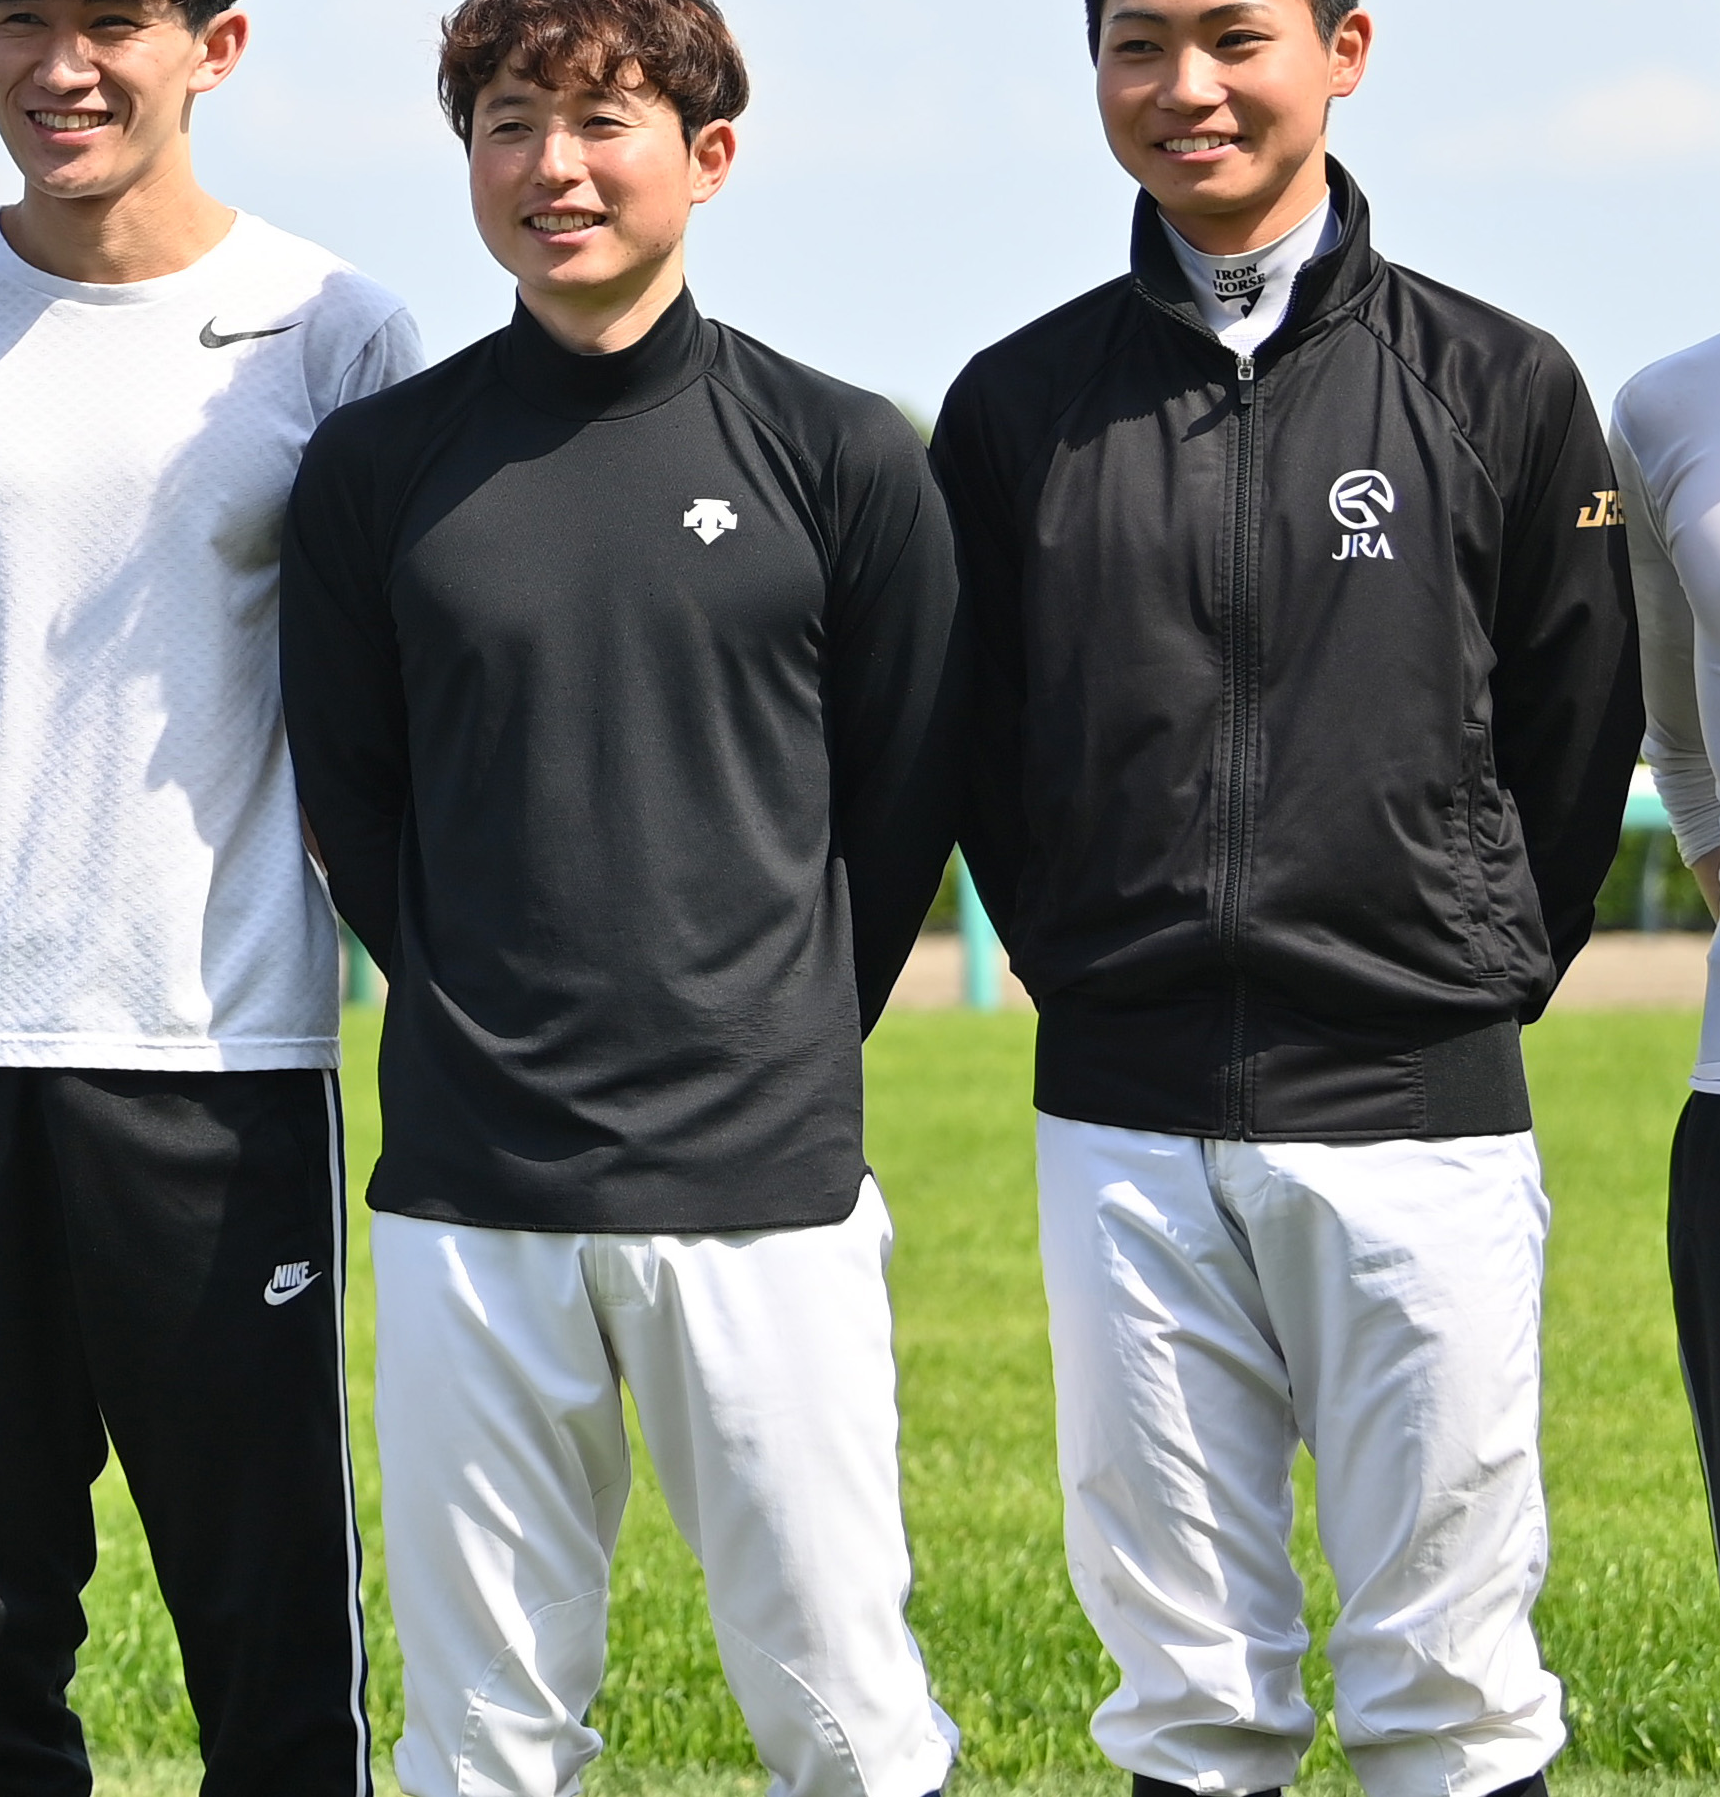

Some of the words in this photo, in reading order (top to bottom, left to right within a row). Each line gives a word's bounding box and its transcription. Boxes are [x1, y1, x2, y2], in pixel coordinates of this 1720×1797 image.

[1212, 273, 1266, 293] HORSE
[1214, 263, 1257, 281] IRON
[1331, 532, 1395, 561] JRA
[272, 1261, 310, 1290] NIKE
